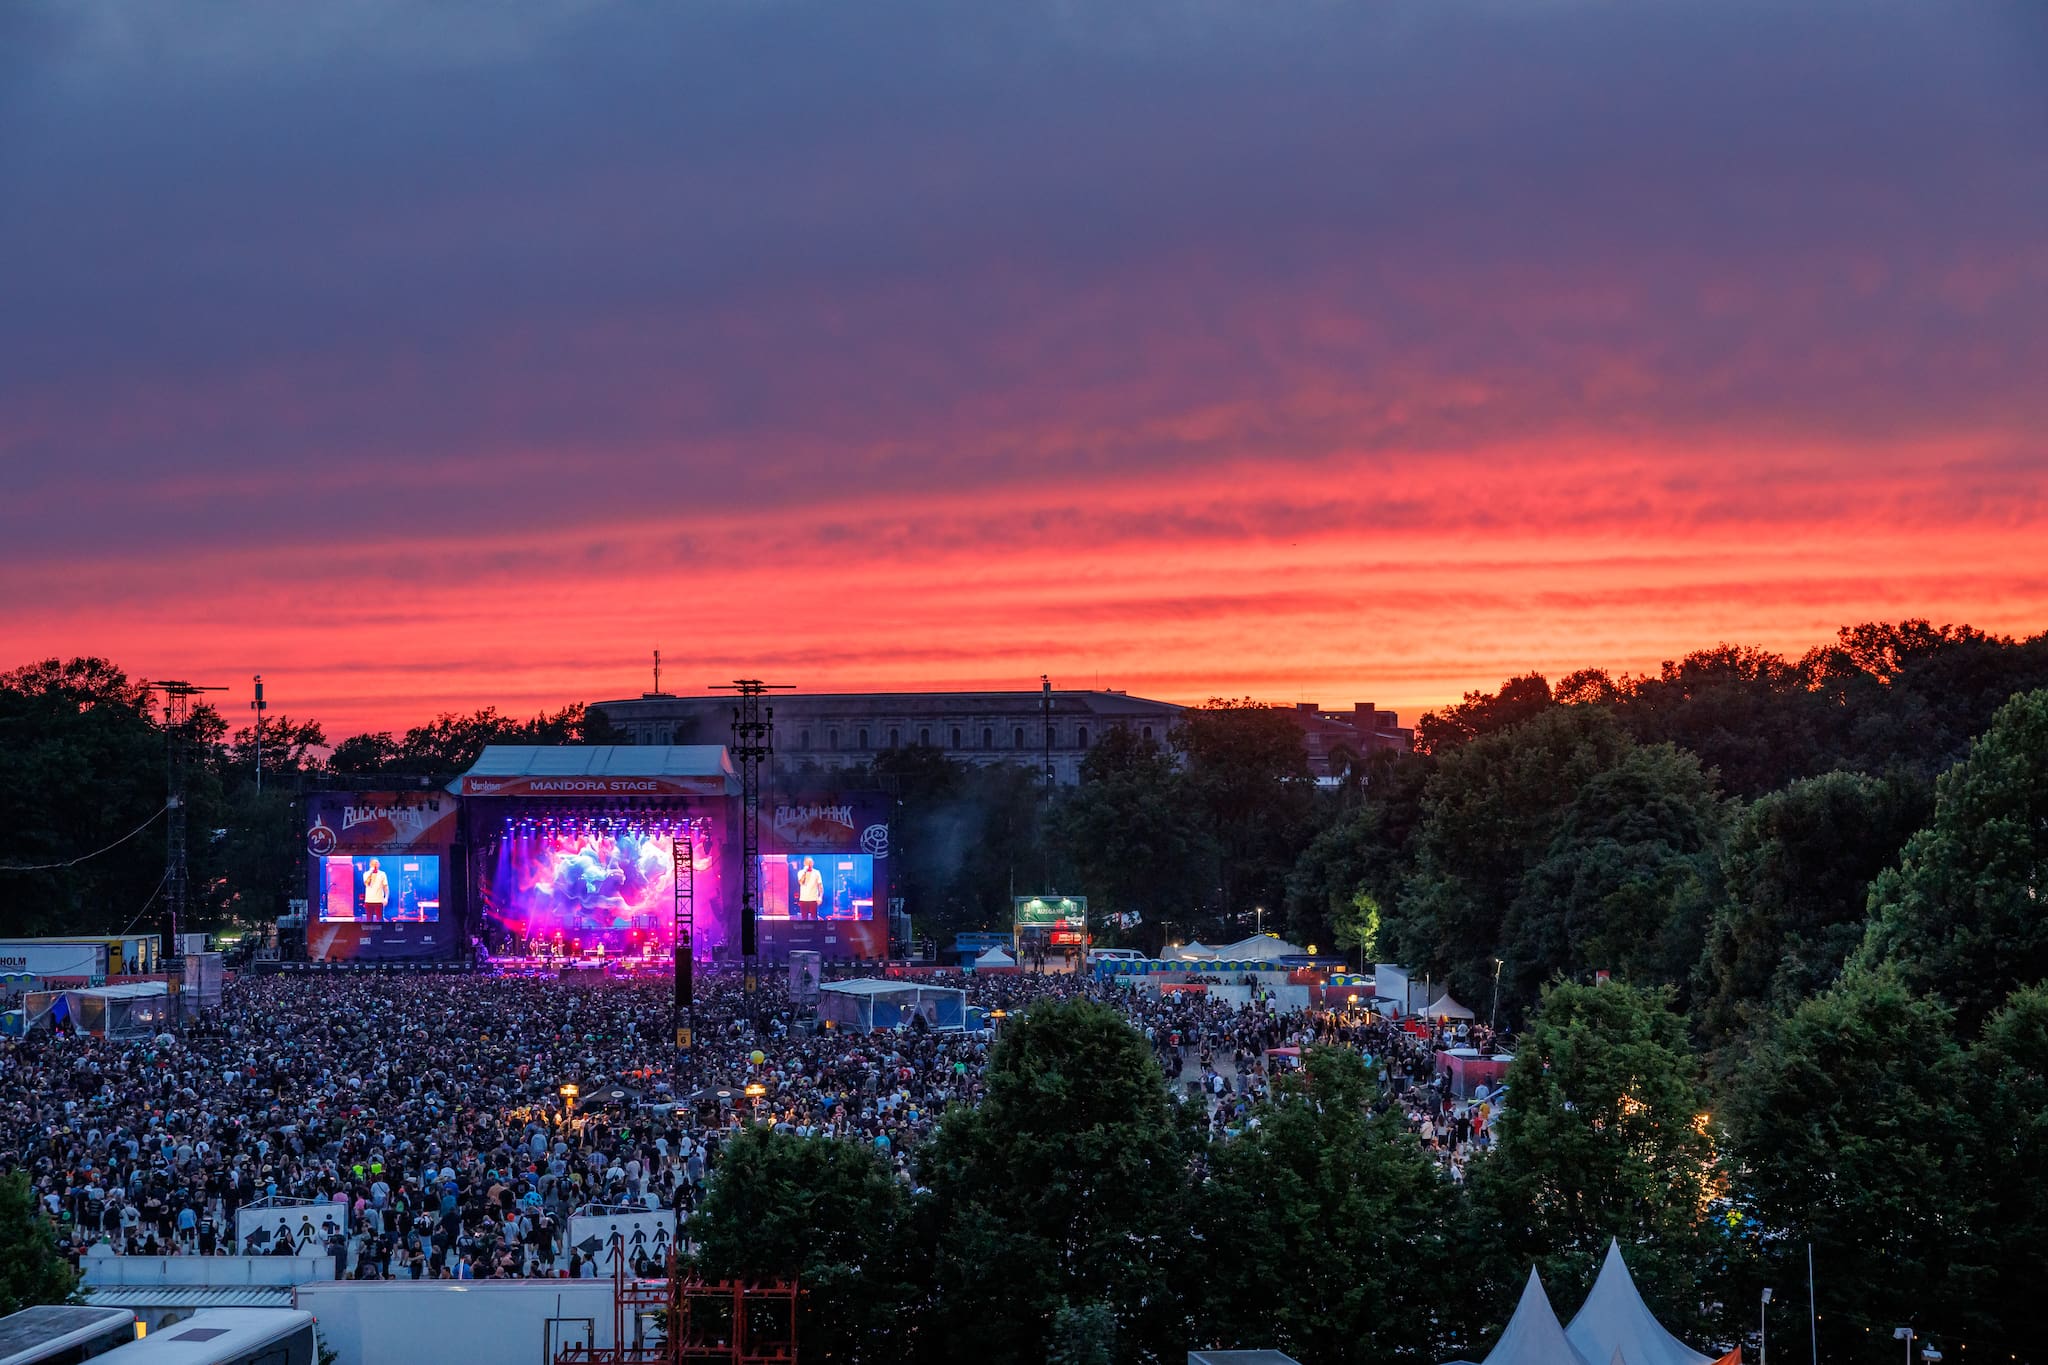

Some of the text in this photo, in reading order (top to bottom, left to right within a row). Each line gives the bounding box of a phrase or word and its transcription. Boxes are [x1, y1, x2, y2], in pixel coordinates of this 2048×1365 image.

[530, 781, 657, 791] MANDORA STAGE
[311, 830, 326, 844] 24
[0, 957, 27, 966] HOLM
